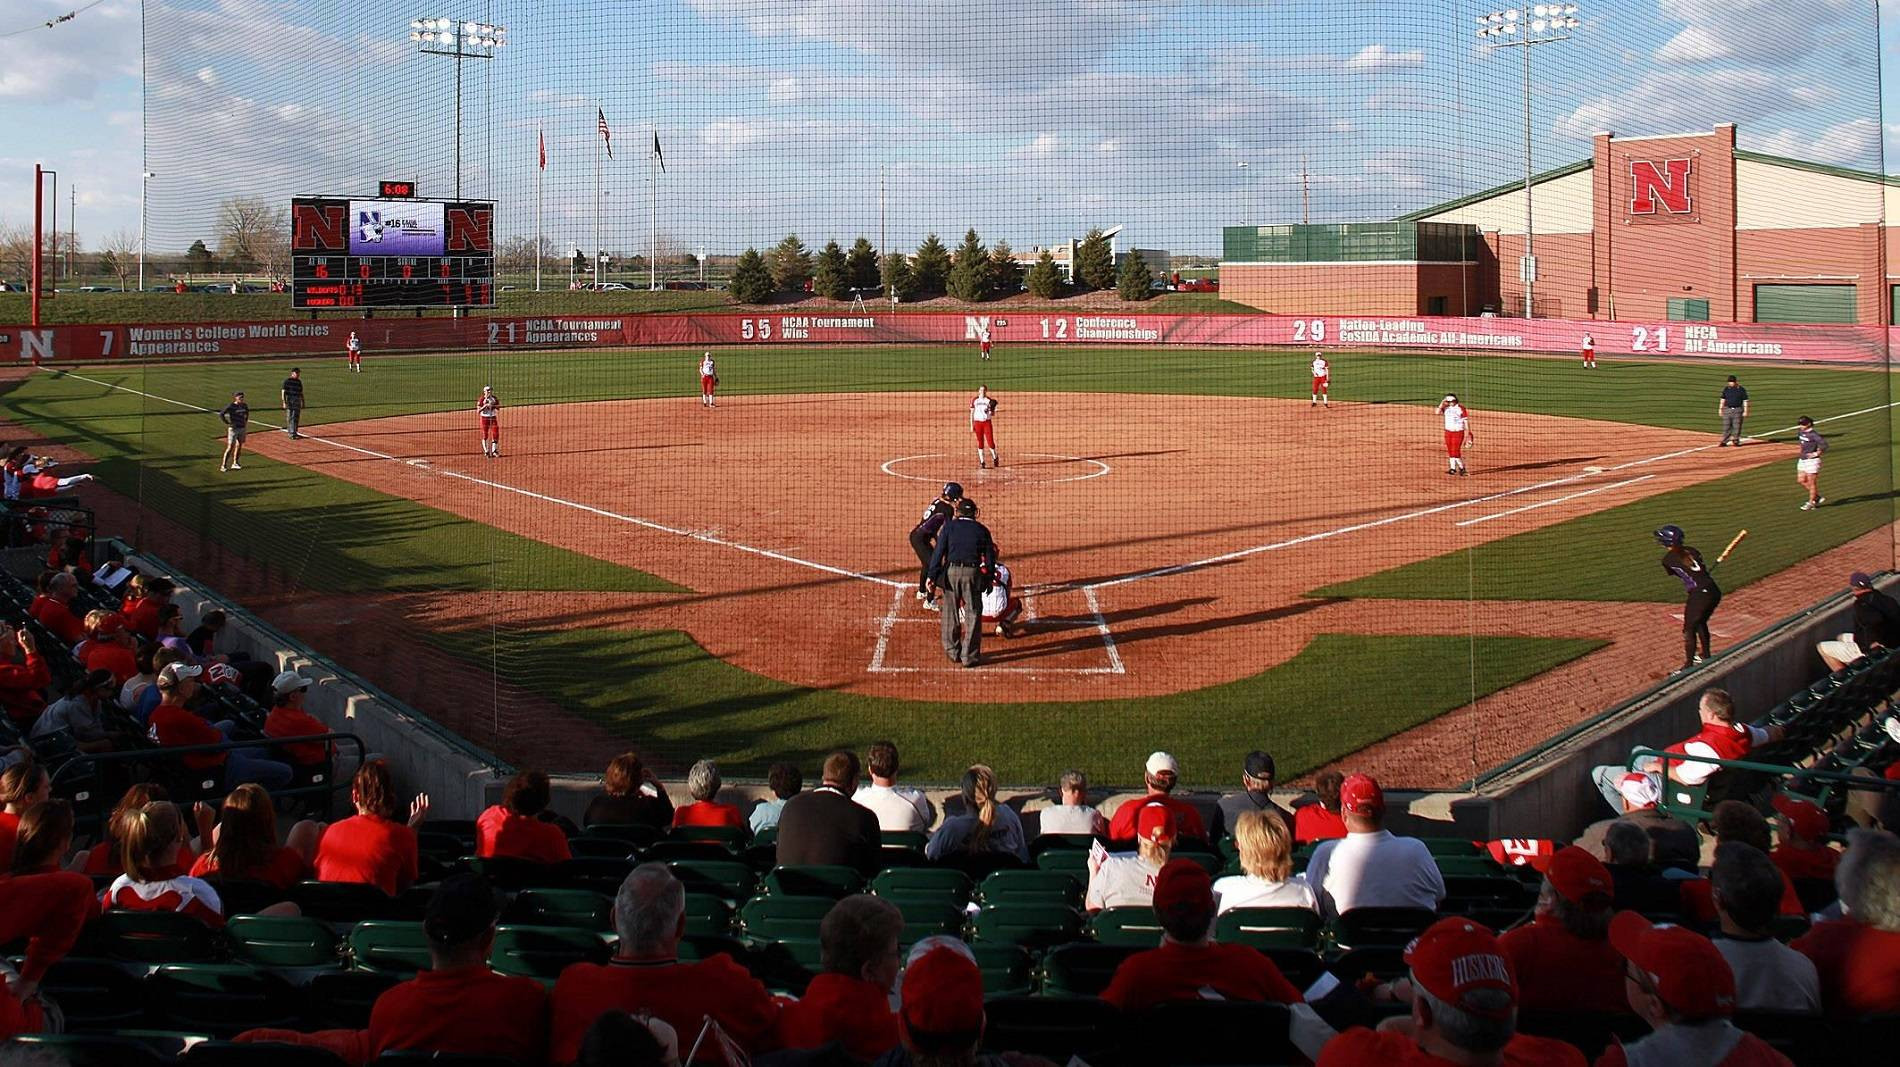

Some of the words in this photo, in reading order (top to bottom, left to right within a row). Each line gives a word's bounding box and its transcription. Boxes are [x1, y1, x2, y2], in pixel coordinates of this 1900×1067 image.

[384, 184, 408, 194] 6:08
[1630, 158, 1692, 215] N
[293, 205, 346, 250] N
[385, 219, 401, 228] #16
[447, 208, 493, 251] N
[525, 319, 554, 331] NCAA
[555, 319, 622, 330] Tournament
[741, 319, 771, 340] 55
[781, 317, 809, 328] NCAA
[811, 318, 875, 328] Tournament
[964, 315, 991, 339] N
[1039, 318, 1068, 339] 12
[1075, 317, 1137, 328] Conference
[1292, 320, 1325, 341] 29
[1339, 319, 1425, 333] Nation-Leading
[129, 327, 192, 342] Women's
[195, 325, 246, 340] College
[248, 324, 286, 338] World
[289, 323, 329, 337] Series
[487, 322, 516, 344] 21
[525, 331, 598, 344] Appearances
[781, 328, 809, 339] Wins
[1075, 327, 1158, 340] Championships
[1339, 331, 1379, 342] CoSIDA
[1381, 331, 1438, 344] Academic
[1440, 333, 1523, 346] All-Americans
[1631, 326, 1670, 351] 21
[1684, 326, 1718, 339] NFCA
[20, 330, 54, 358] N
[99, 331, 114, 355] 7
[129, 340, 220, 356] Appearances
[1684, 340, 1783, 355] All-Americans
[1451, 953, 1511, 988] HUSKERS
